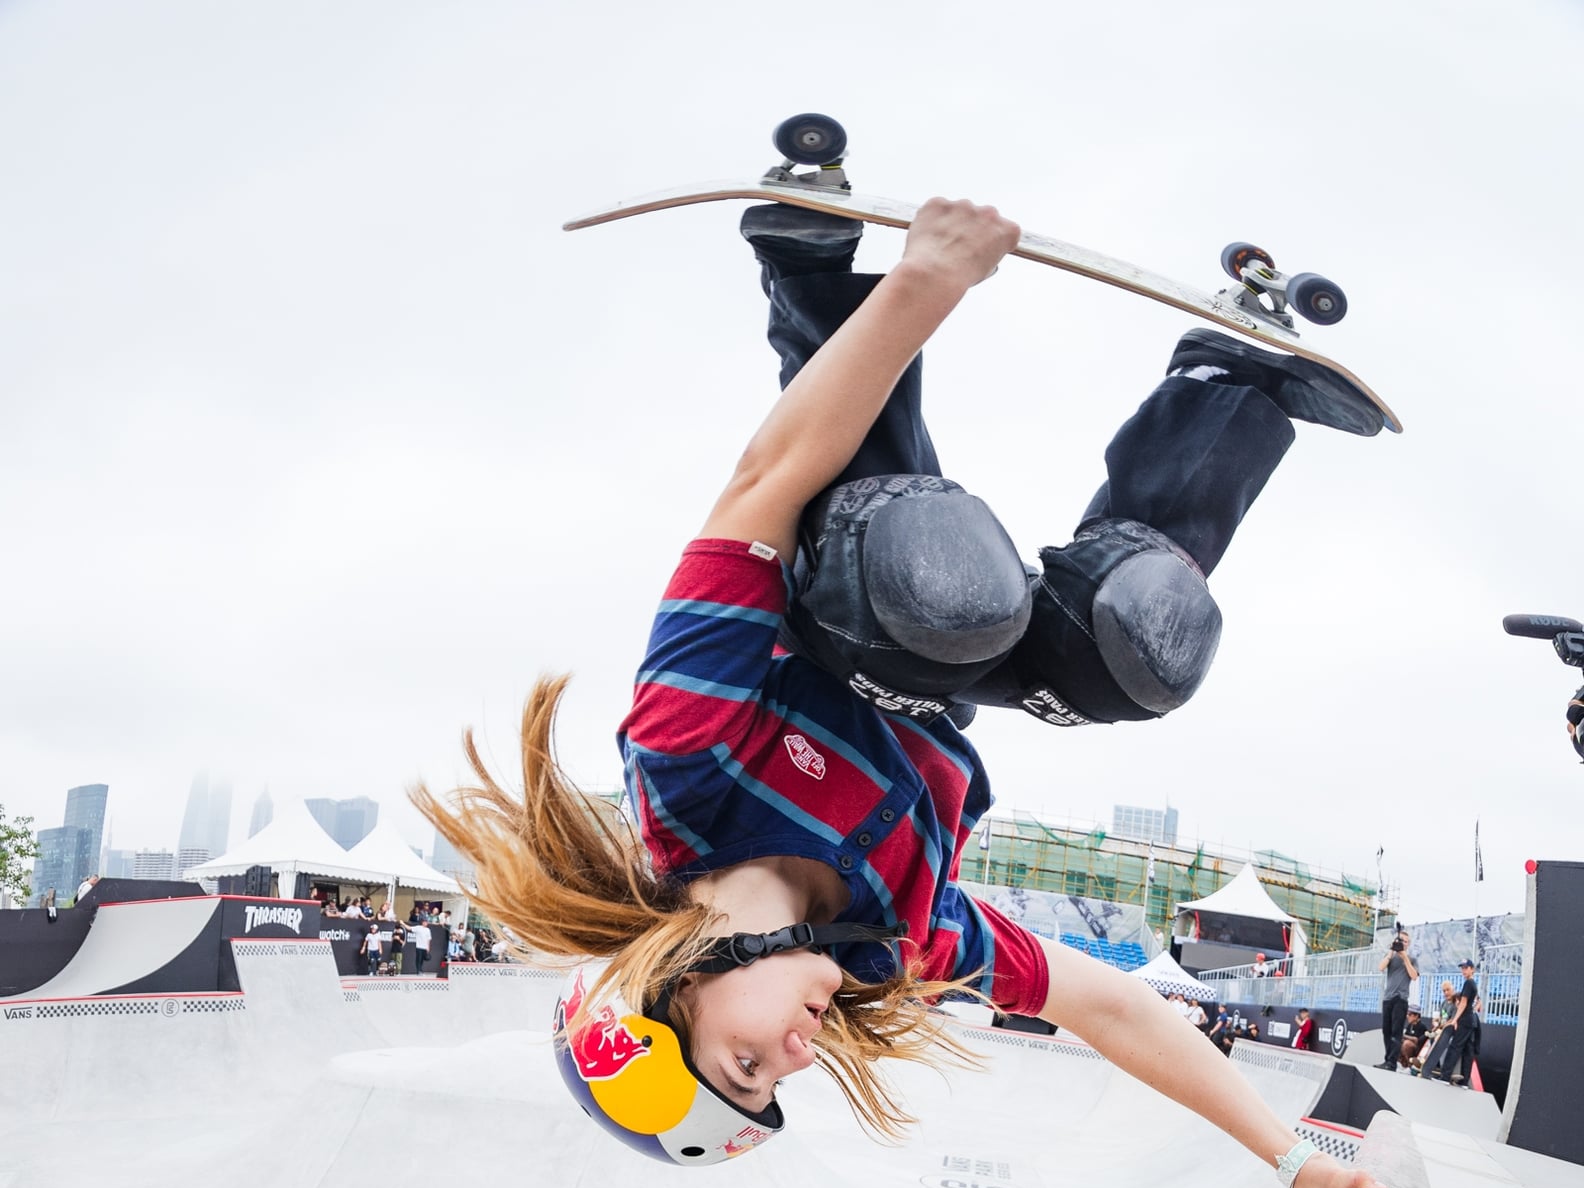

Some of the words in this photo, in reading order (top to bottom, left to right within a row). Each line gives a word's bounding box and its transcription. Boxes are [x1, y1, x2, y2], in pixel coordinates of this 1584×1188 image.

[855, 673, 894, 698] PADS
[893, 696, 945, 713] KILLER
[1035, 690, 1068, 714] PADS
[1023, 700, 1072, 724] 87
[244, 905, 303, 935] THRASHER
[278, 944, 298, 955] VANS
[498, 968, 518, 977] VANS
[3, 1006, 33, 1020] VANS
[1028, 1040, 1050, 1051] VANS
